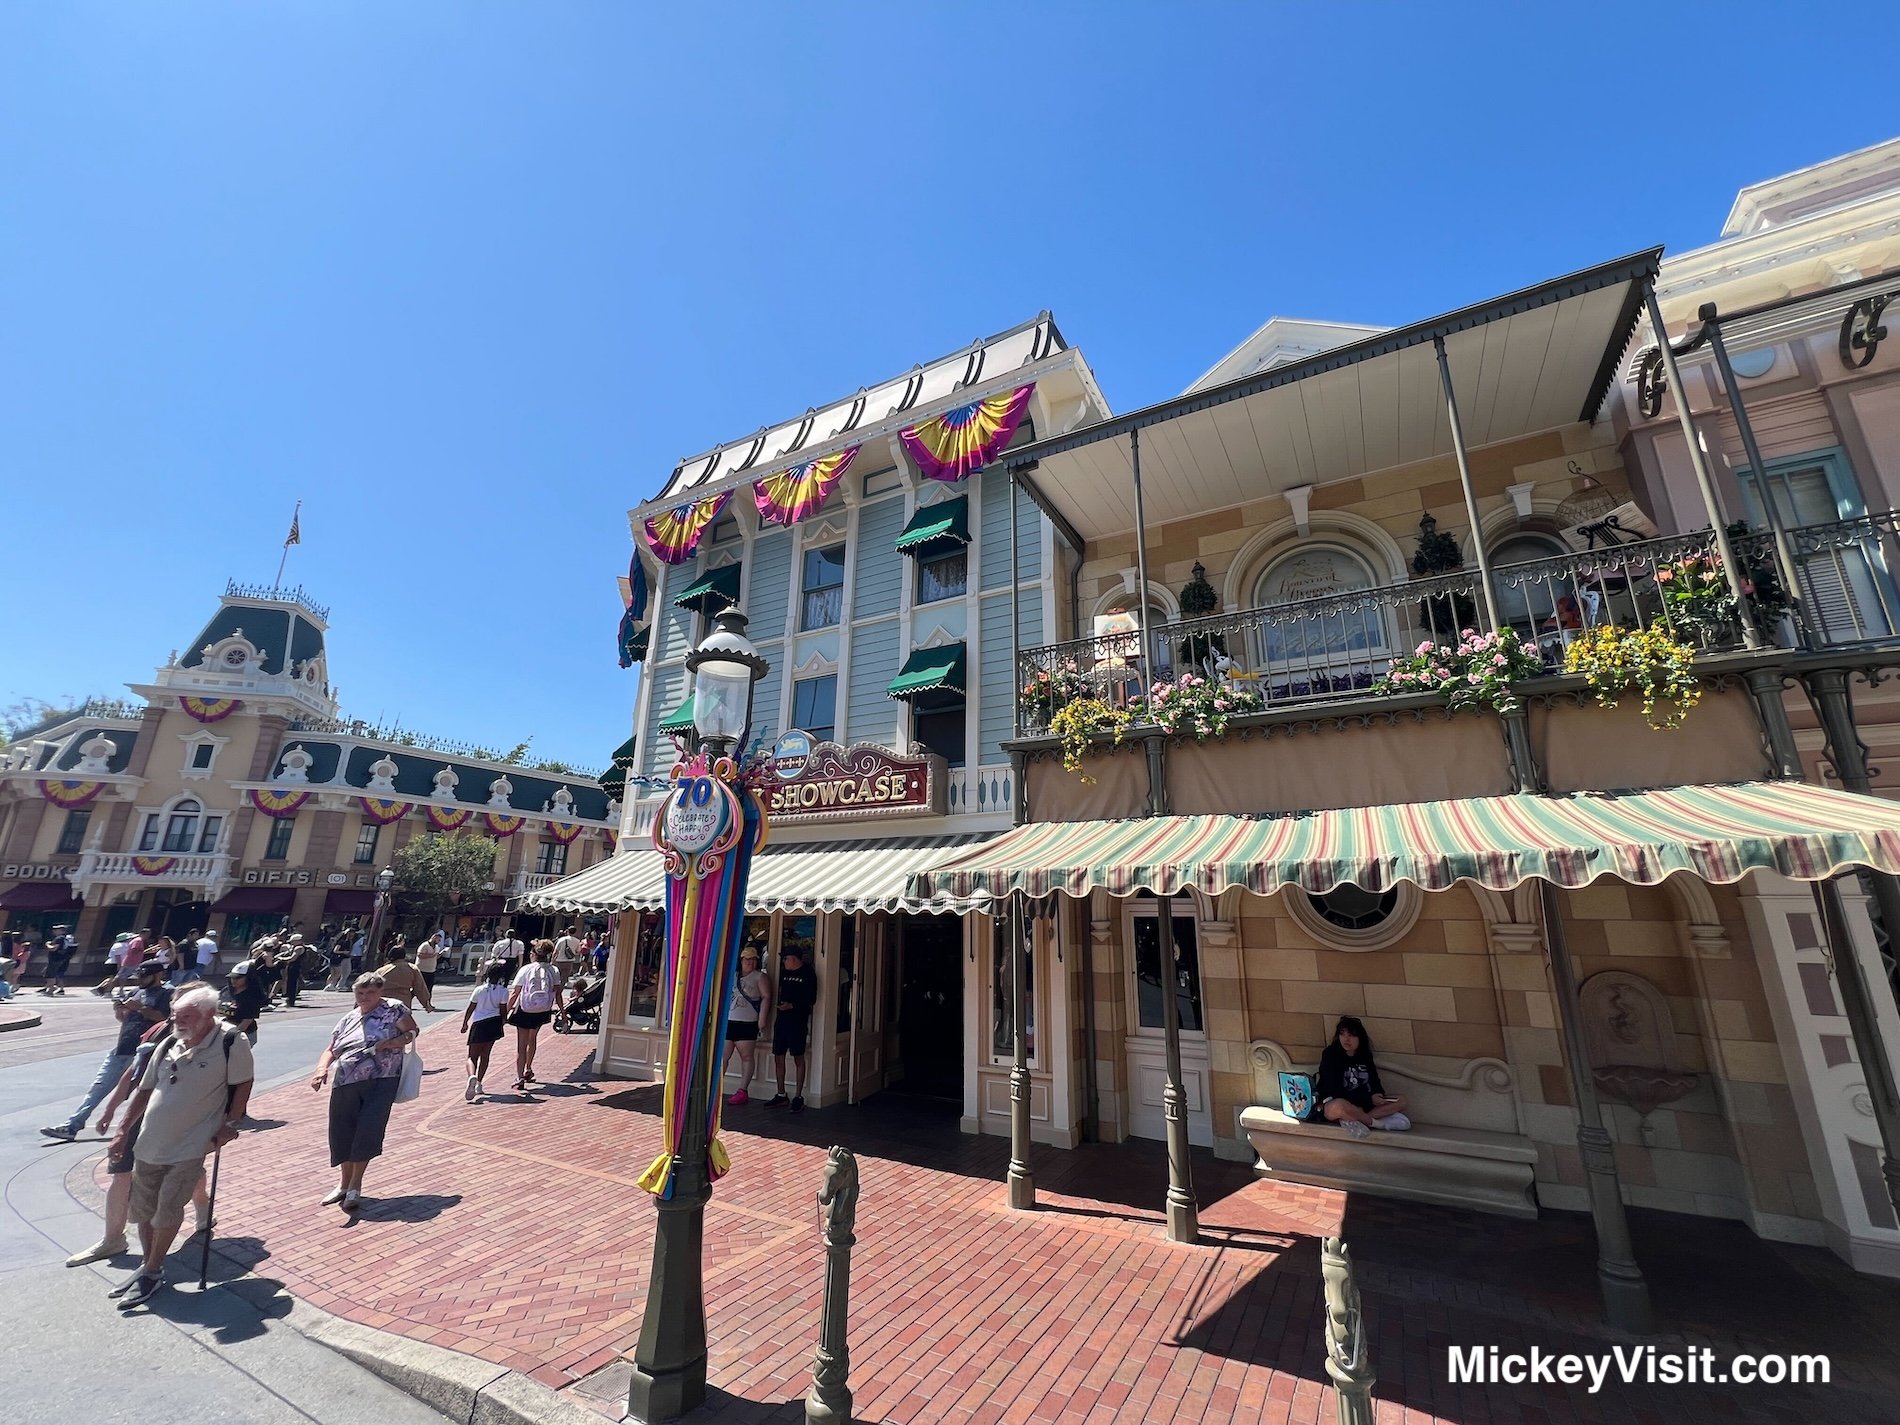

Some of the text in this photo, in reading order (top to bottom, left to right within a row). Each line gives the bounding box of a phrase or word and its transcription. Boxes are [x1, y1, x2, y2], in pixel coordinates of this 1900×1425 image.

[677, 777, 713, 808] 70
[770, 774, 907, 809] SHOWCASE
[678, 823, 702, 835] HAPPY
[245, 870, 310, 884] GIFTS
